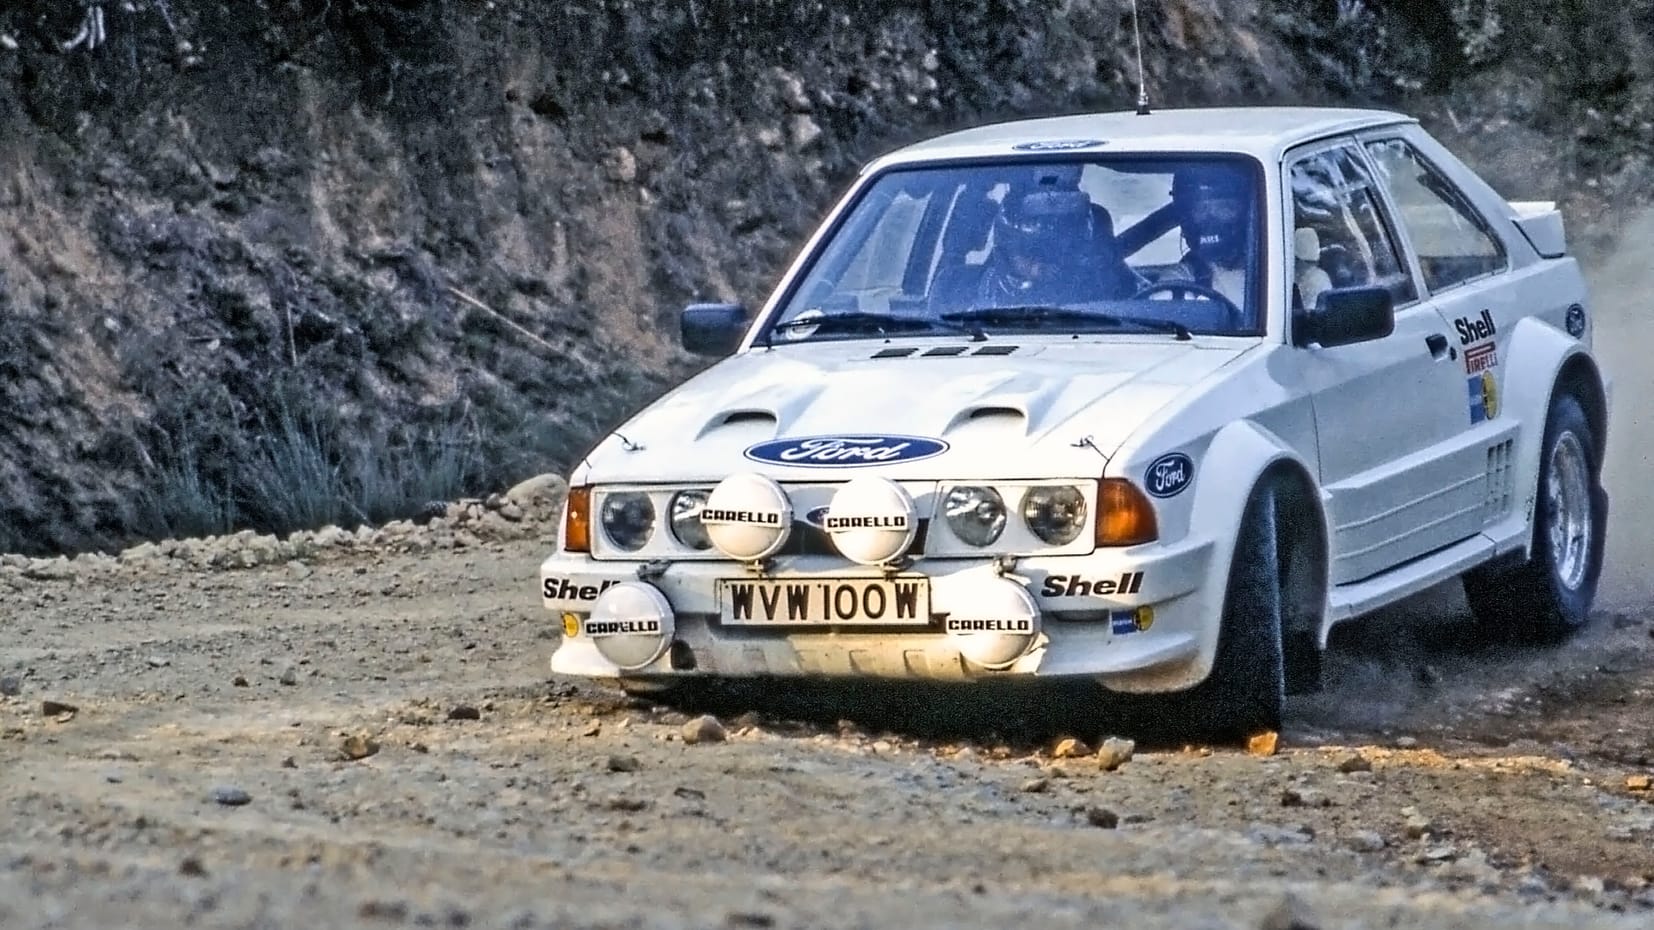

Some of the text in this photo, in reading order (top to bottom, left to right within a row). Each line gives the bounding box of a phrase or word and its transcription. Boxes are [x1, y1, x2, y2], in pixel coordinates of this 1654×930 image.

[1455, 309, 1496, 345] Shell
[1464, 341, 1499, 374] PIRELLI
[780, 437, 911, 461] Ford
[1155, 460, 1185, 491] Ford
[702, 508, 779, 524] CARELLO
[827, 515, 906, 529] CARELLO
[543, 577, 622, 601] Shel
[1041, 571, 1144, 598] Shell
[731, 583, 810, 621] WVW
[585, 620, 659, 634] CARELLO
[949, 619, 1029, 632] CARELLO
